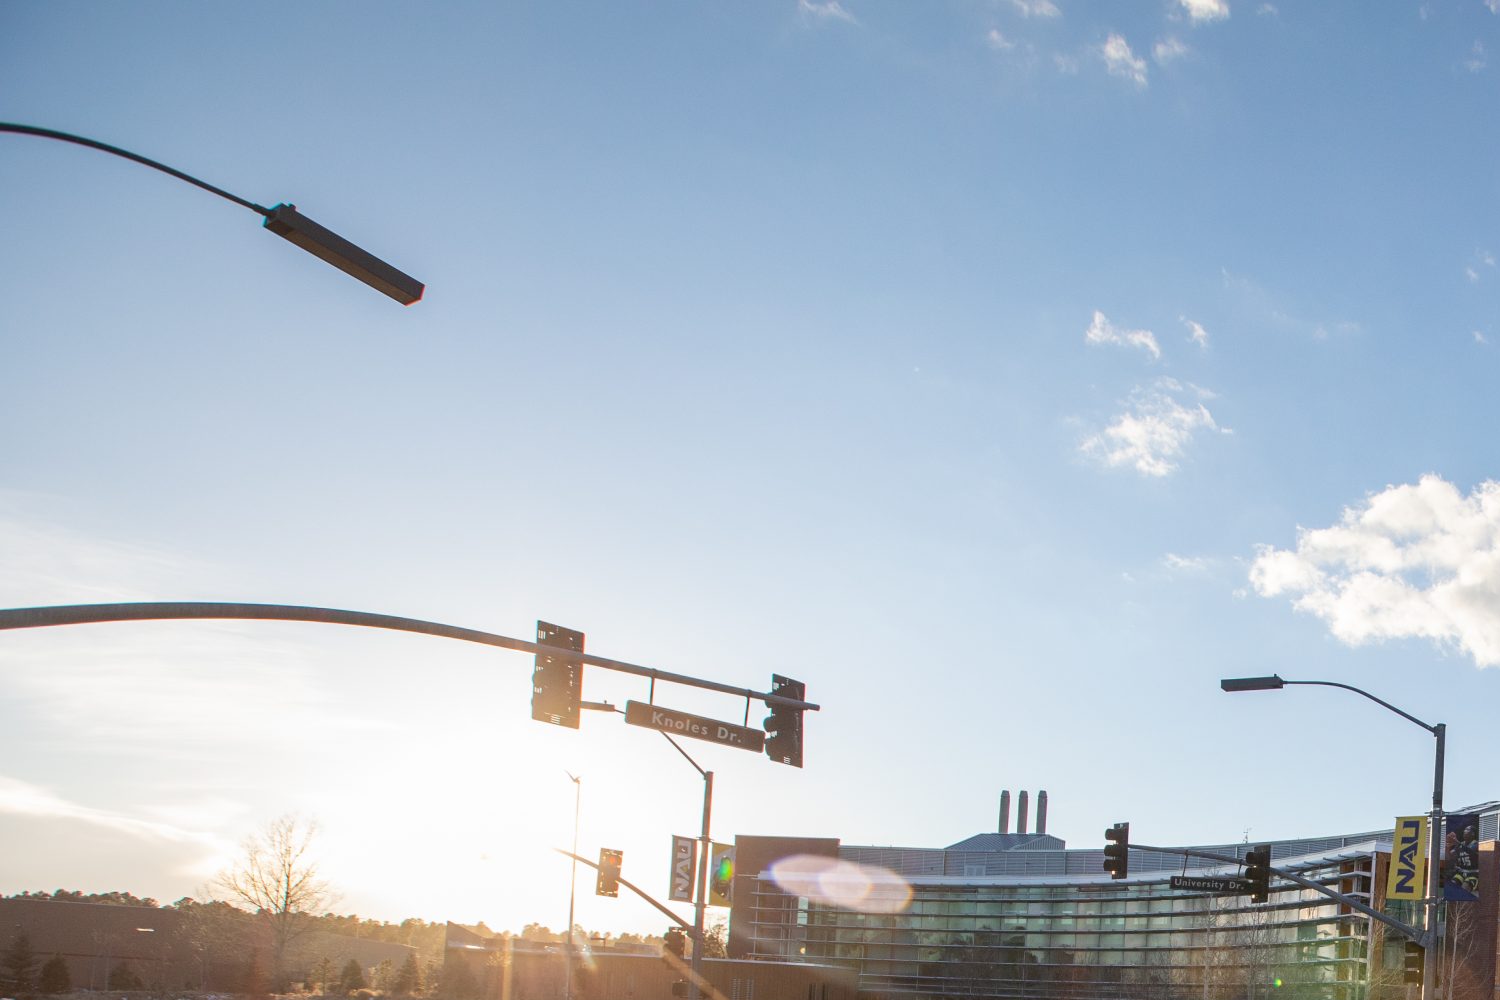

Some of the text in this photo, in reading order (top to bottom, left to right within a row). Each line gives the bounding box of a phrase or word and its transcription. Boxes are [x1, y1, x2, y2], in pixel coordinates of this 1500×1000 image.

[652, 711, 742, 743] Knoles Dr.
[674, 839, 692, 899] NAU
[1396, 820, 1420, 894] NAU
[1174, 878, 1245, 890] University Dr.
